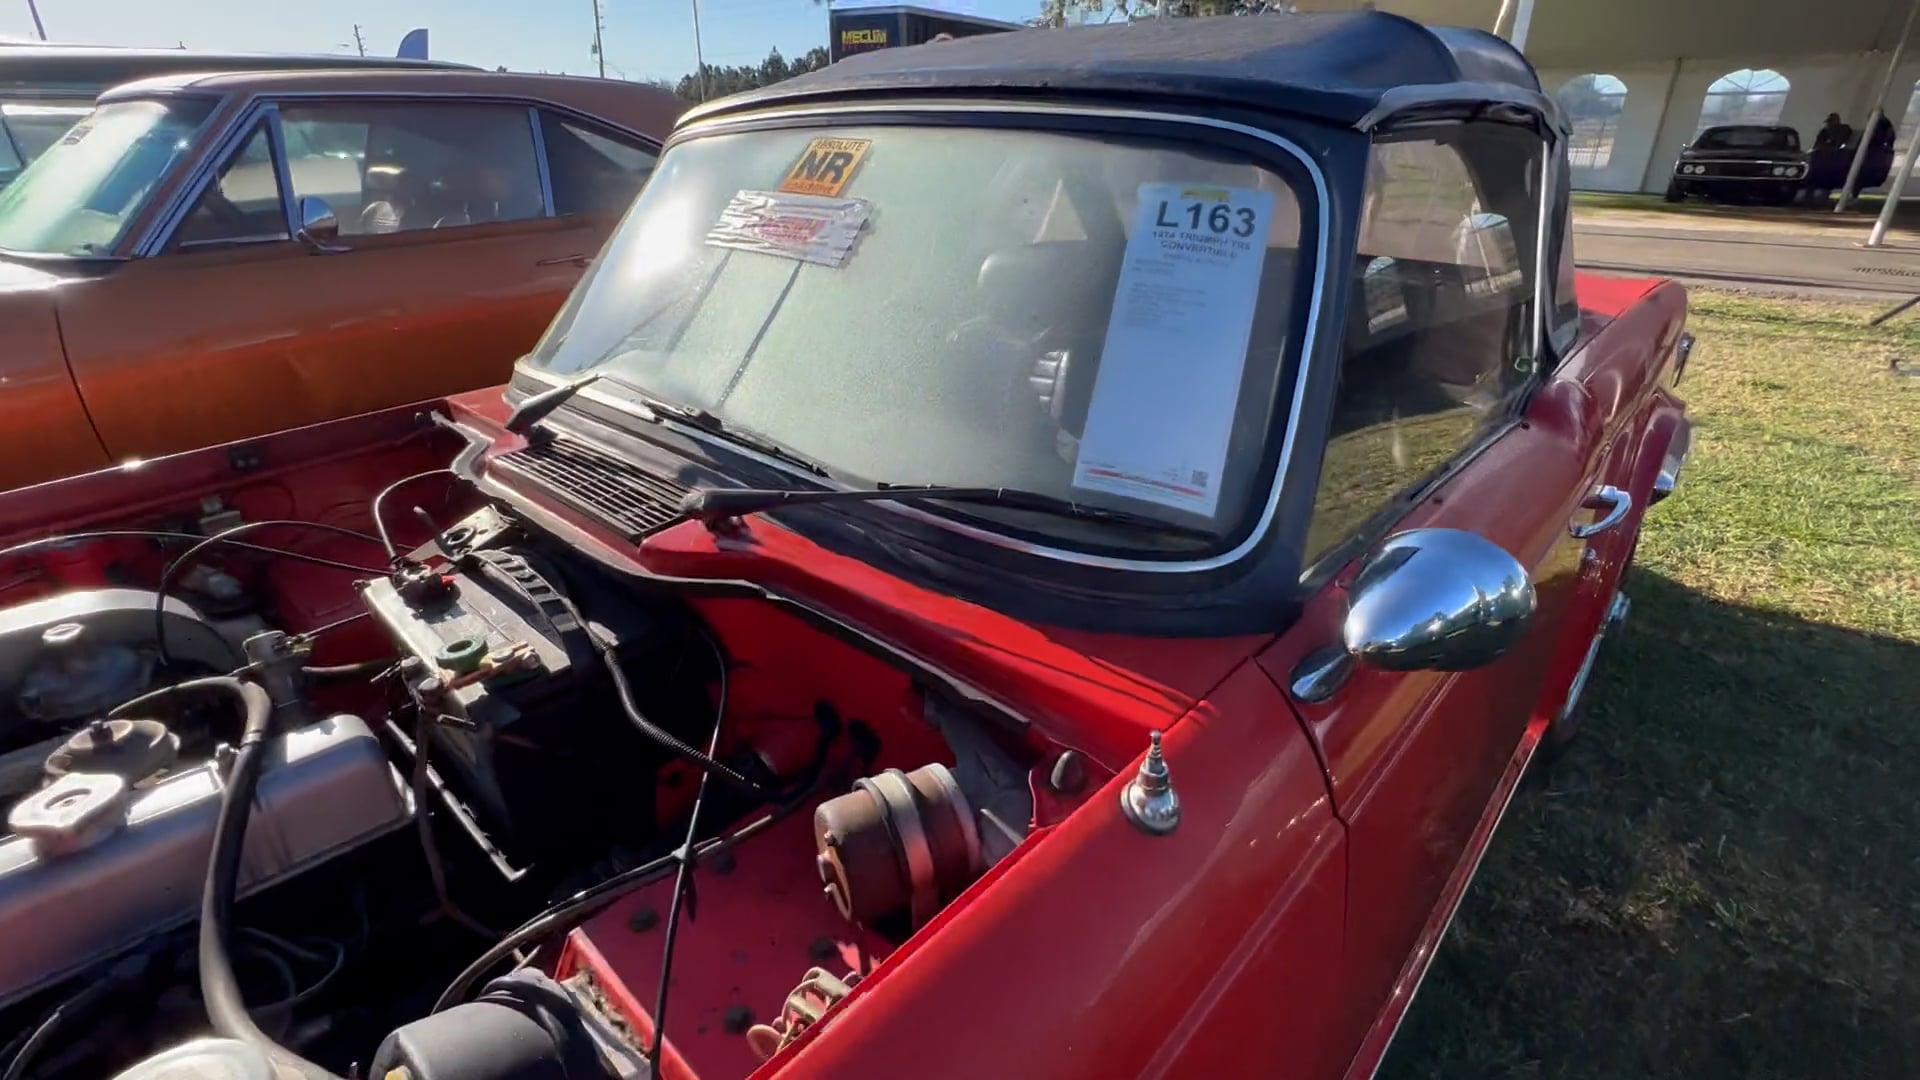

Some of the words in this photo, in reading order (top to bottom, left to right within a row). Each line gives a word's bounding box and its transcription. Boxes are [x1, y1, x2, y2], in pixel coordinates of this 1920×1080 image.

[815, 138, 865, 152] ABSOLUTE
[791, 149, 854, 184] NR
[1156, 201, 1256, 238] L163
